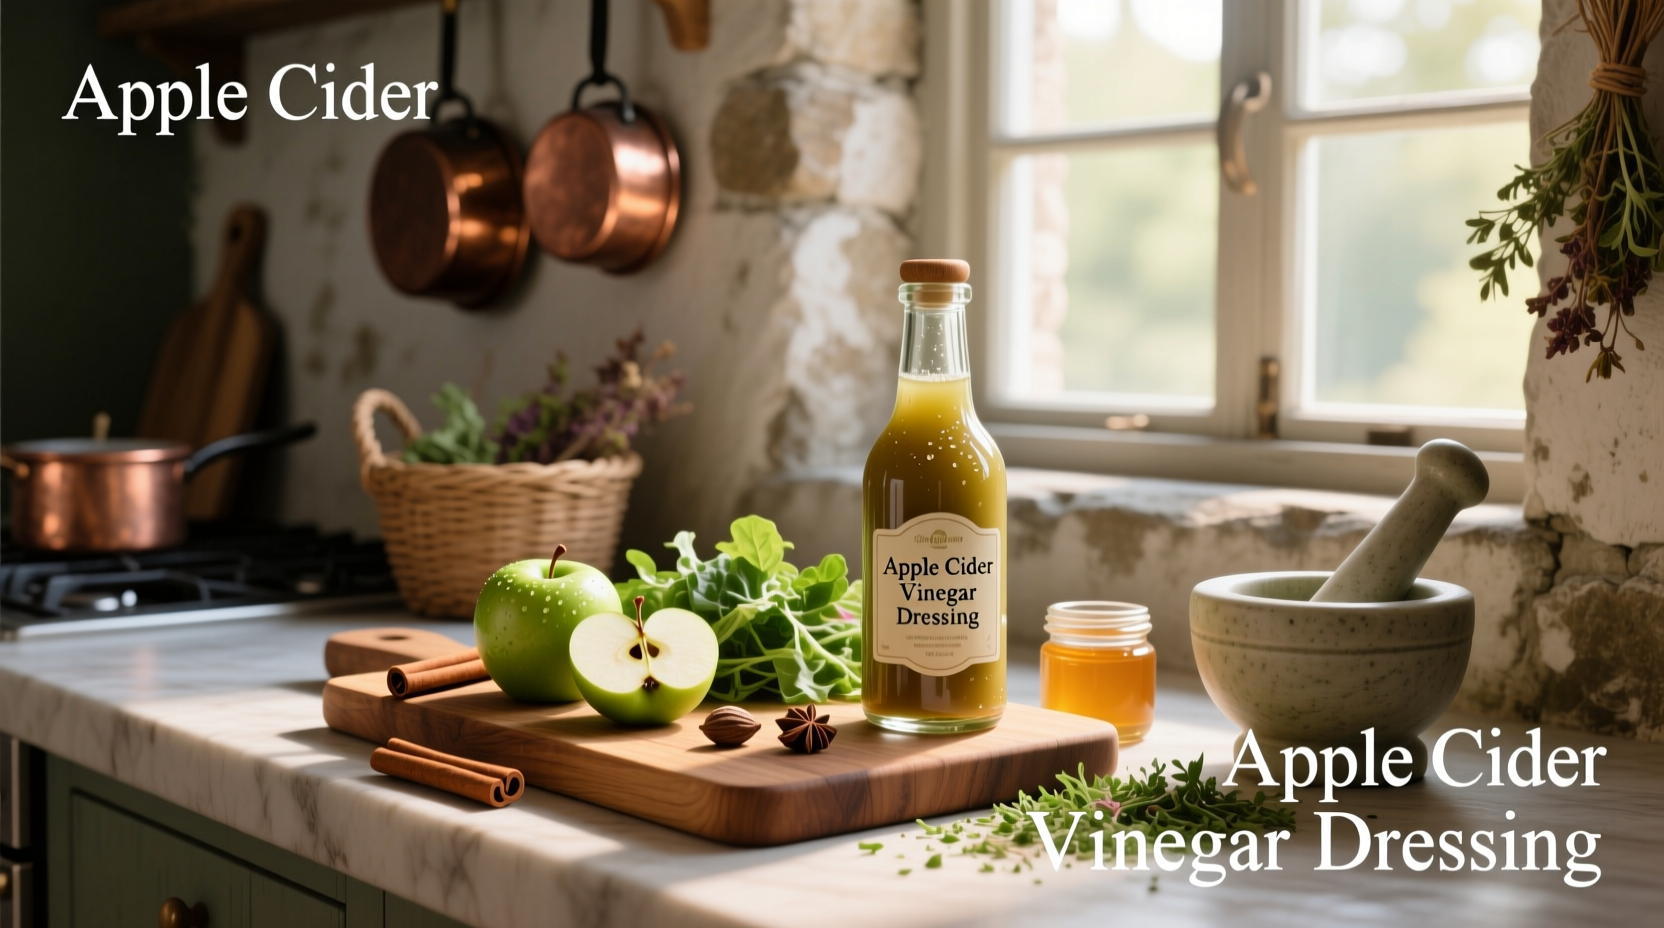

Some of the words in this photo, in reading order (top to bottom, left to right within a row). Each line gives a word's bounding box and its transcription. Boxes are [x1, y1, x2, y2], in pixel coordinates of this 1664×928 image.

[882, 556, 939, 581] Apple
[945, 556, 993, 575] Cider
[899, 582, 977, 607] Vinegar
[896, 606, 980, 629] Dressing
